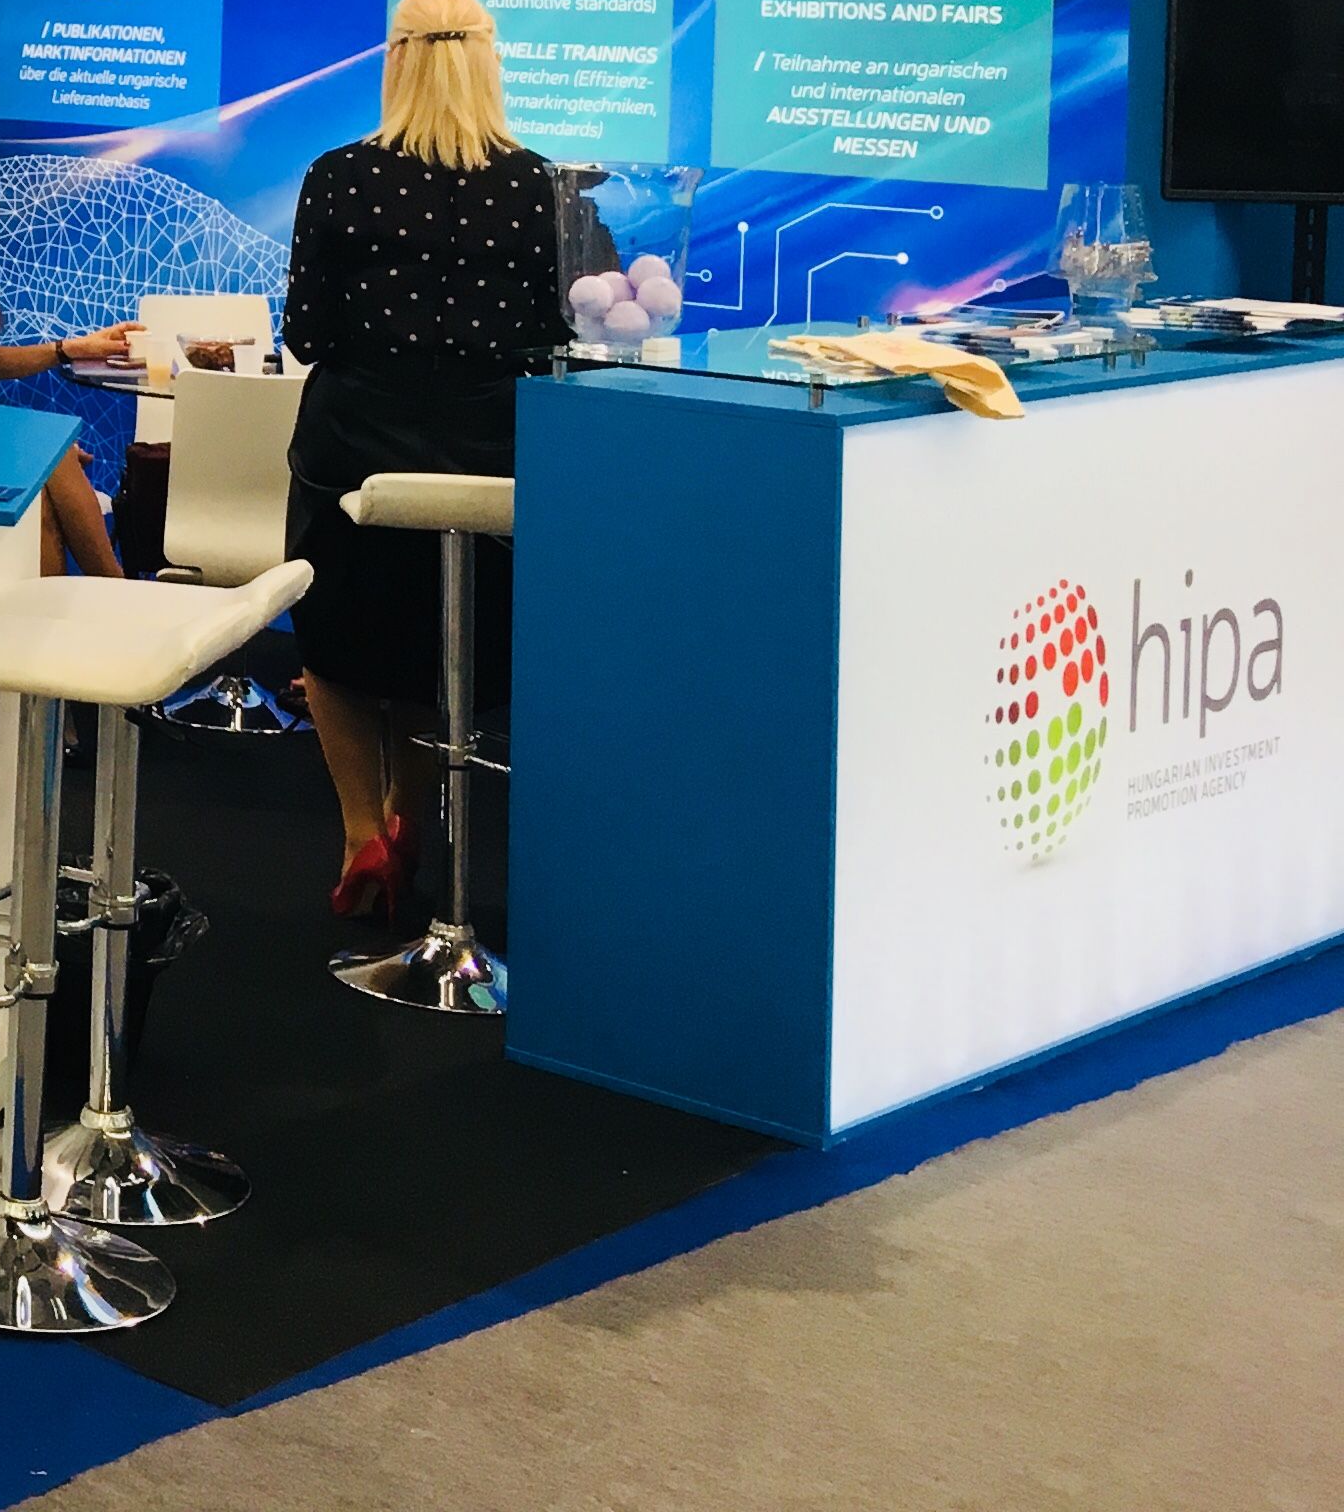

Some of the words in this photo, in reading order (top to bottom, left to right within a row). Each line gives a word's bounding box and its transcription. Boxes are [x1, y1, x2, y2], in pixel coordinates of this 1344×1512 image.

[761, 0, 886, 20] EXHIBITIONS
[891, 4, 937, 22] AND
[942, 6, 1003, 25] FAIRS
[52, 22, 165, 44] PUBLIKATIONEN,
[22, 44, 186, 66] MARKTINFORMATIONEN
[562, 44, 658, 64] TRAININGS
[20, 66, 46, 82] über
[49, 67, 67, 82] die
[69, 69, 115, 85] aktuelle
[118, 72, 187, 90] ungarische
[773, 54, 861, 74] Teilnahme
[865, 61, 889, 75] an
[894, 61, 1007, 80] ungarischen
[574, 70, 654, 88] (Effizienz-
[52, 89, 150, 109] Lieferantenbasis
[791, 83, 825, 99] und
[830, 83, 965, 106] internationalen
[766, 106, 938, 132] AUSSTELLUNGEN
[944, 115, 990, 134] UND
[833, 137, 918, 158] MESSEN
[1129, 569, 1283, 739] hipa
[1128, 766, 1201, 796] HUNGARIAN
[1204, 736, 1280, 772] INVESTMENT
[1127, 790, 1198, 820] PROMOTION
[1201, 771, 1247, 799] AGENCY
